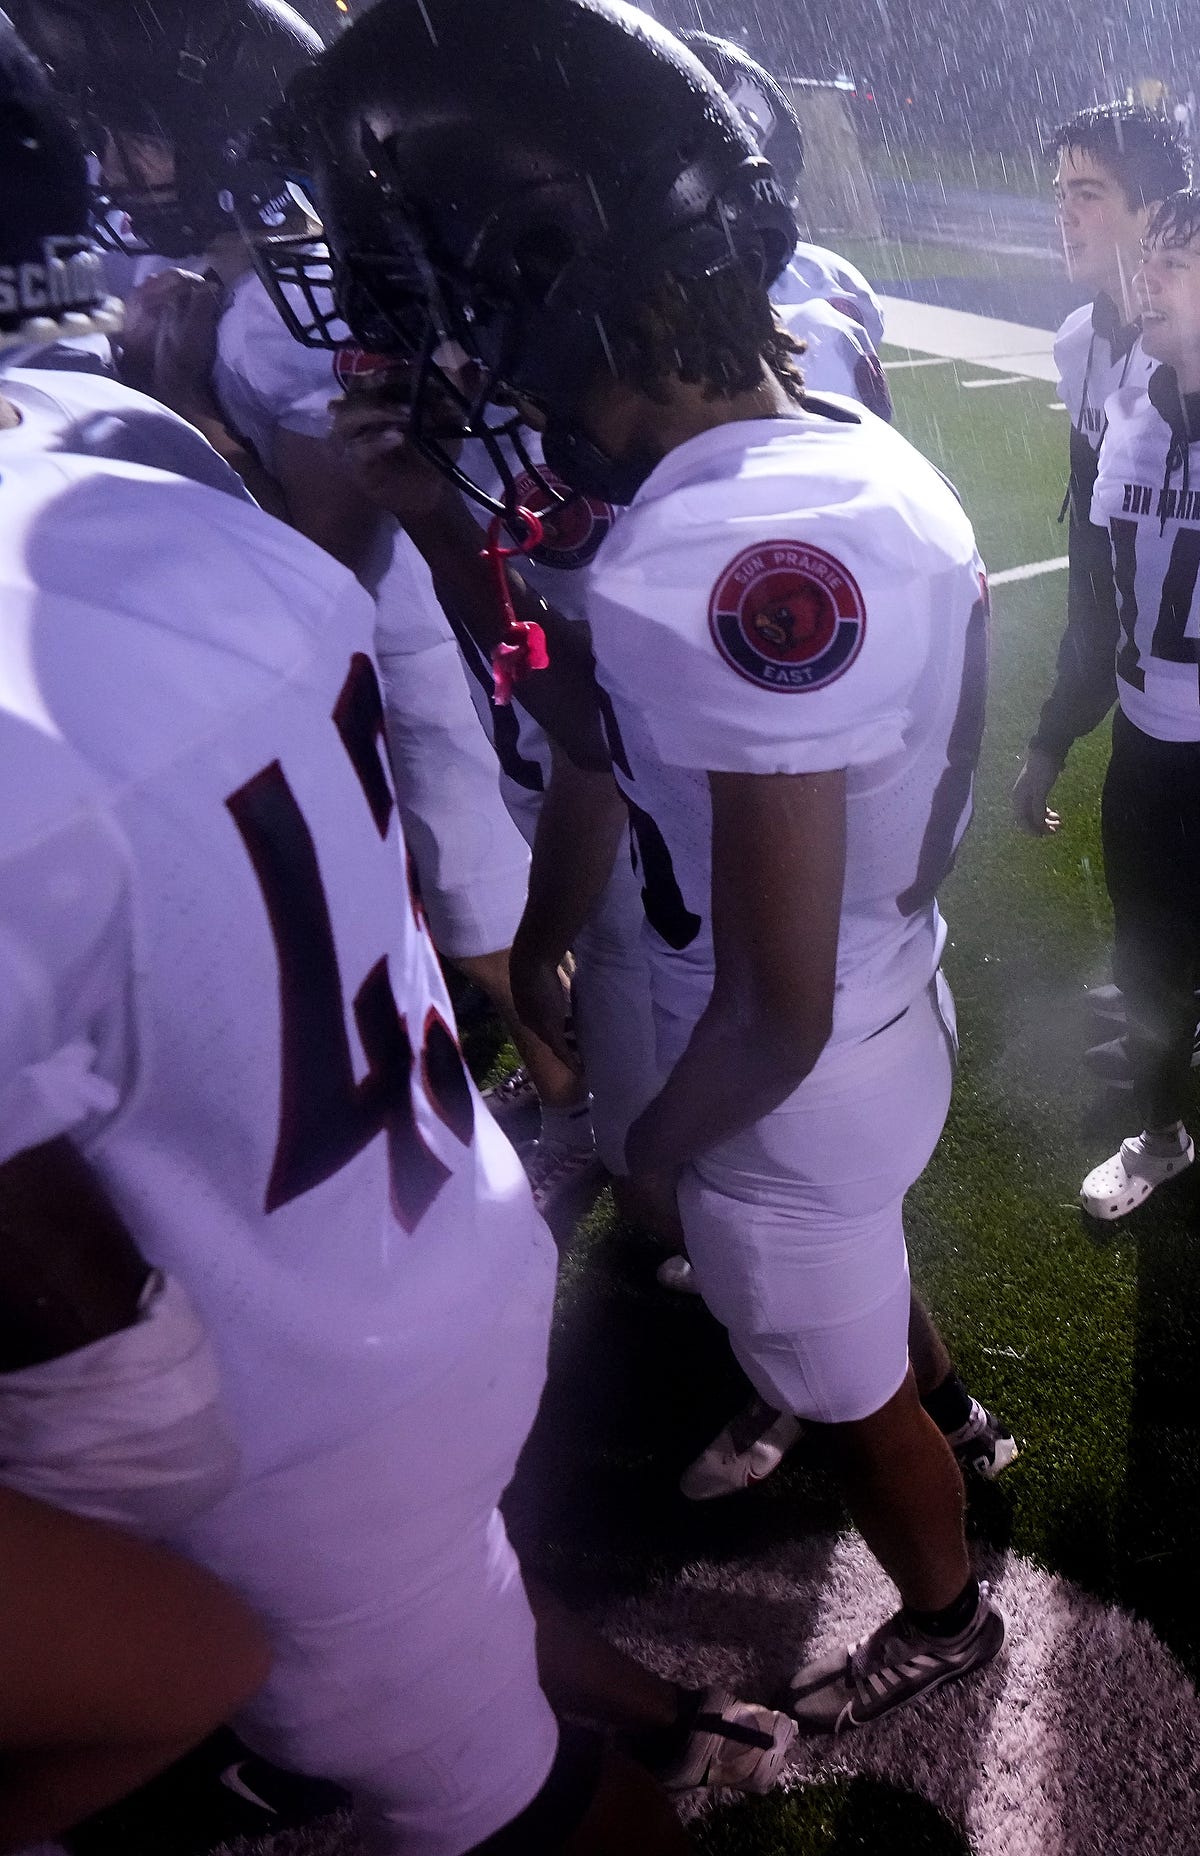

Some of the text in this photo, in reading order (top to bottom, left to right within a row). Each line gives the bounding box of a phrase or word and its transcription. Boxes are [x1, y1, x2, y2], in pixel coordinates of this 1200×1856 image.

[1121, 484, 1153, 516] SUN
[733, 551, 843, 590] SUN PRAIRIE
[762, 664, 814, 684] EAST
